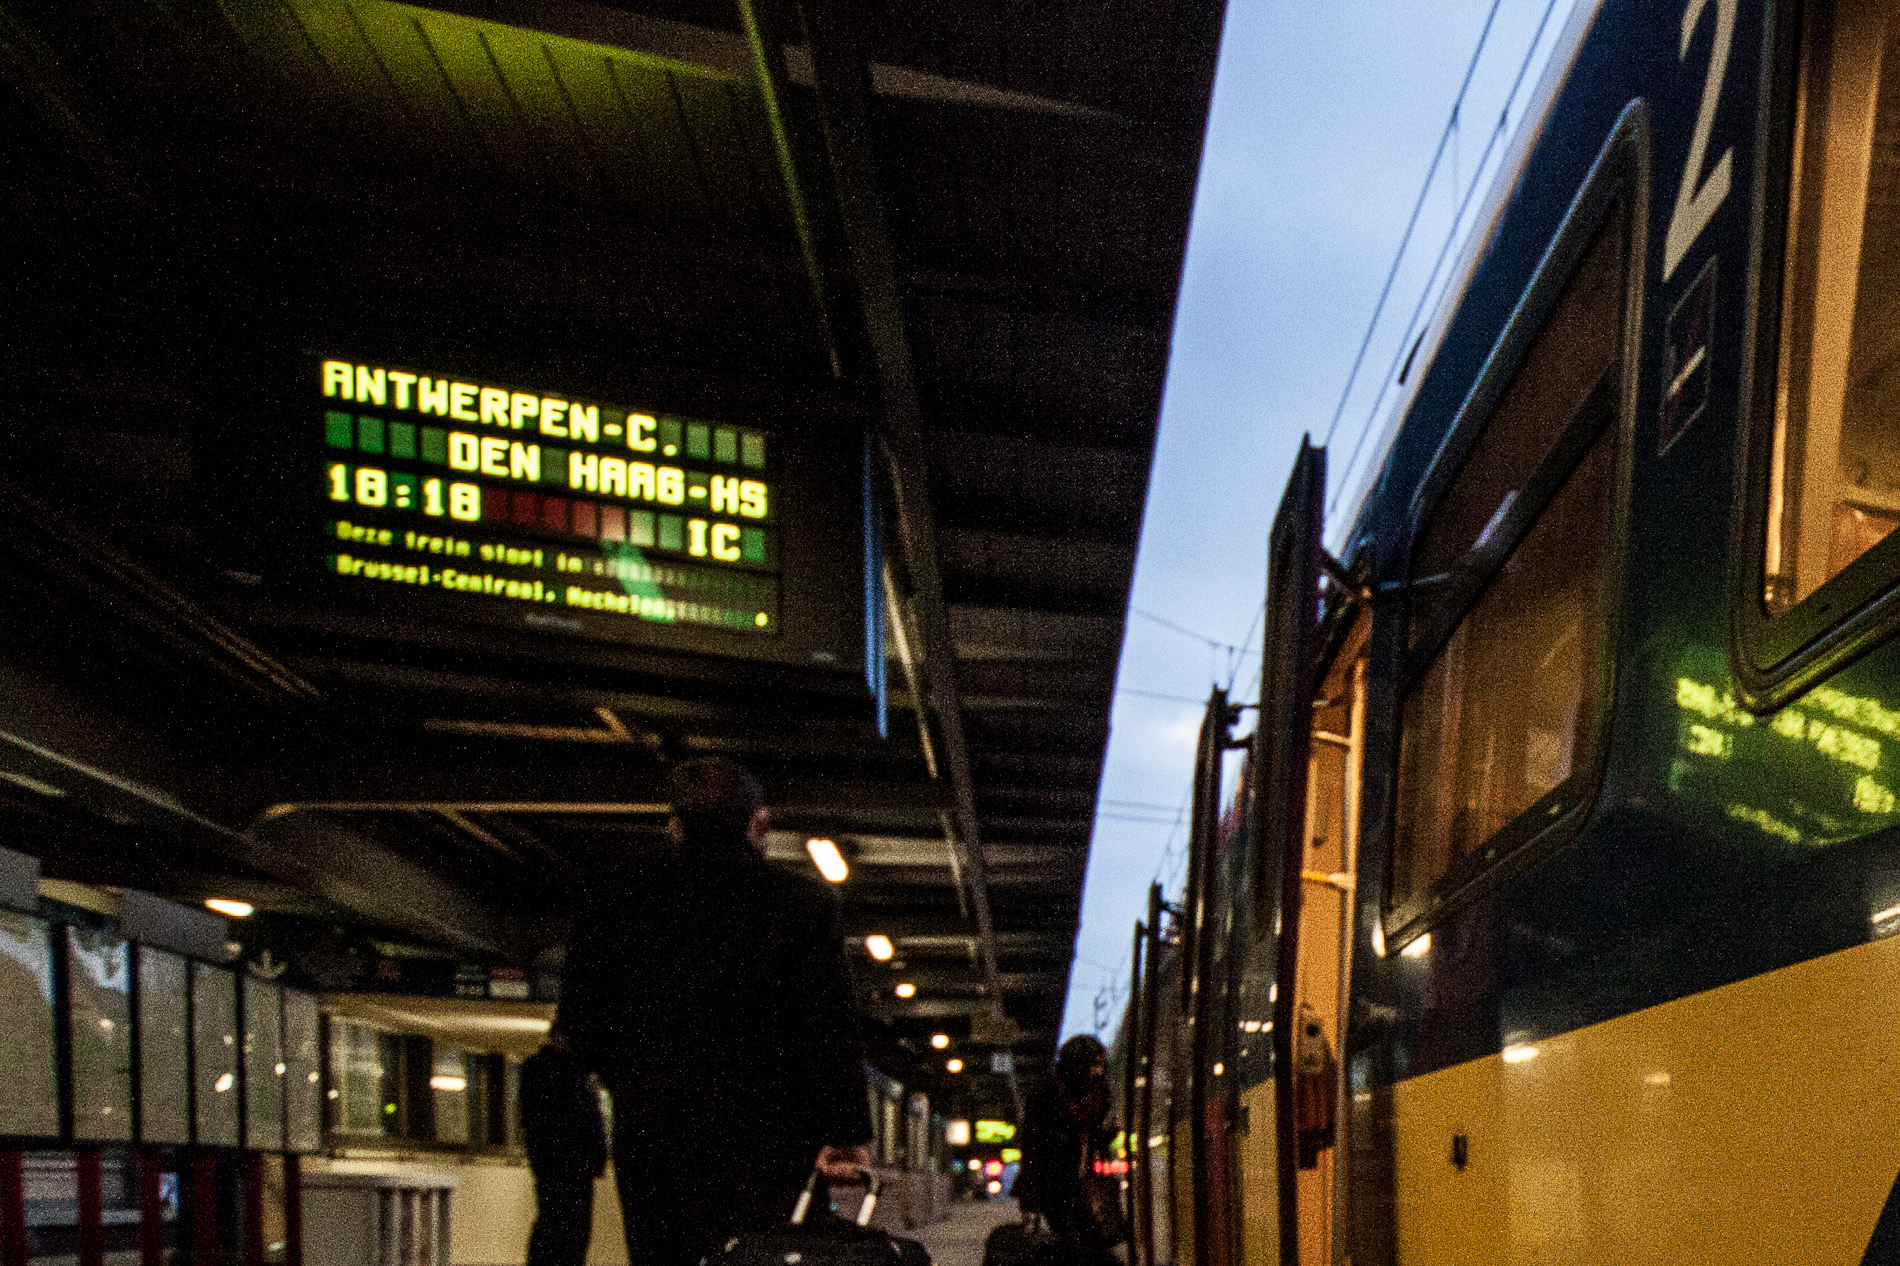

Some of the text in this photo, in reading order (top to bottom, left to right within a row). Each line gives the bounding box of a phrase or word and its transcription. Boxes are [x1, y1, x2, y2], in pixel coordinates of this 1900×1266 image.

[322, 359, 678, 457] ANTWERPEN-C.
[328, 463, 742, 562] 18:18 IC
[447, 430, 769, 519] DEN HAAG-HS
